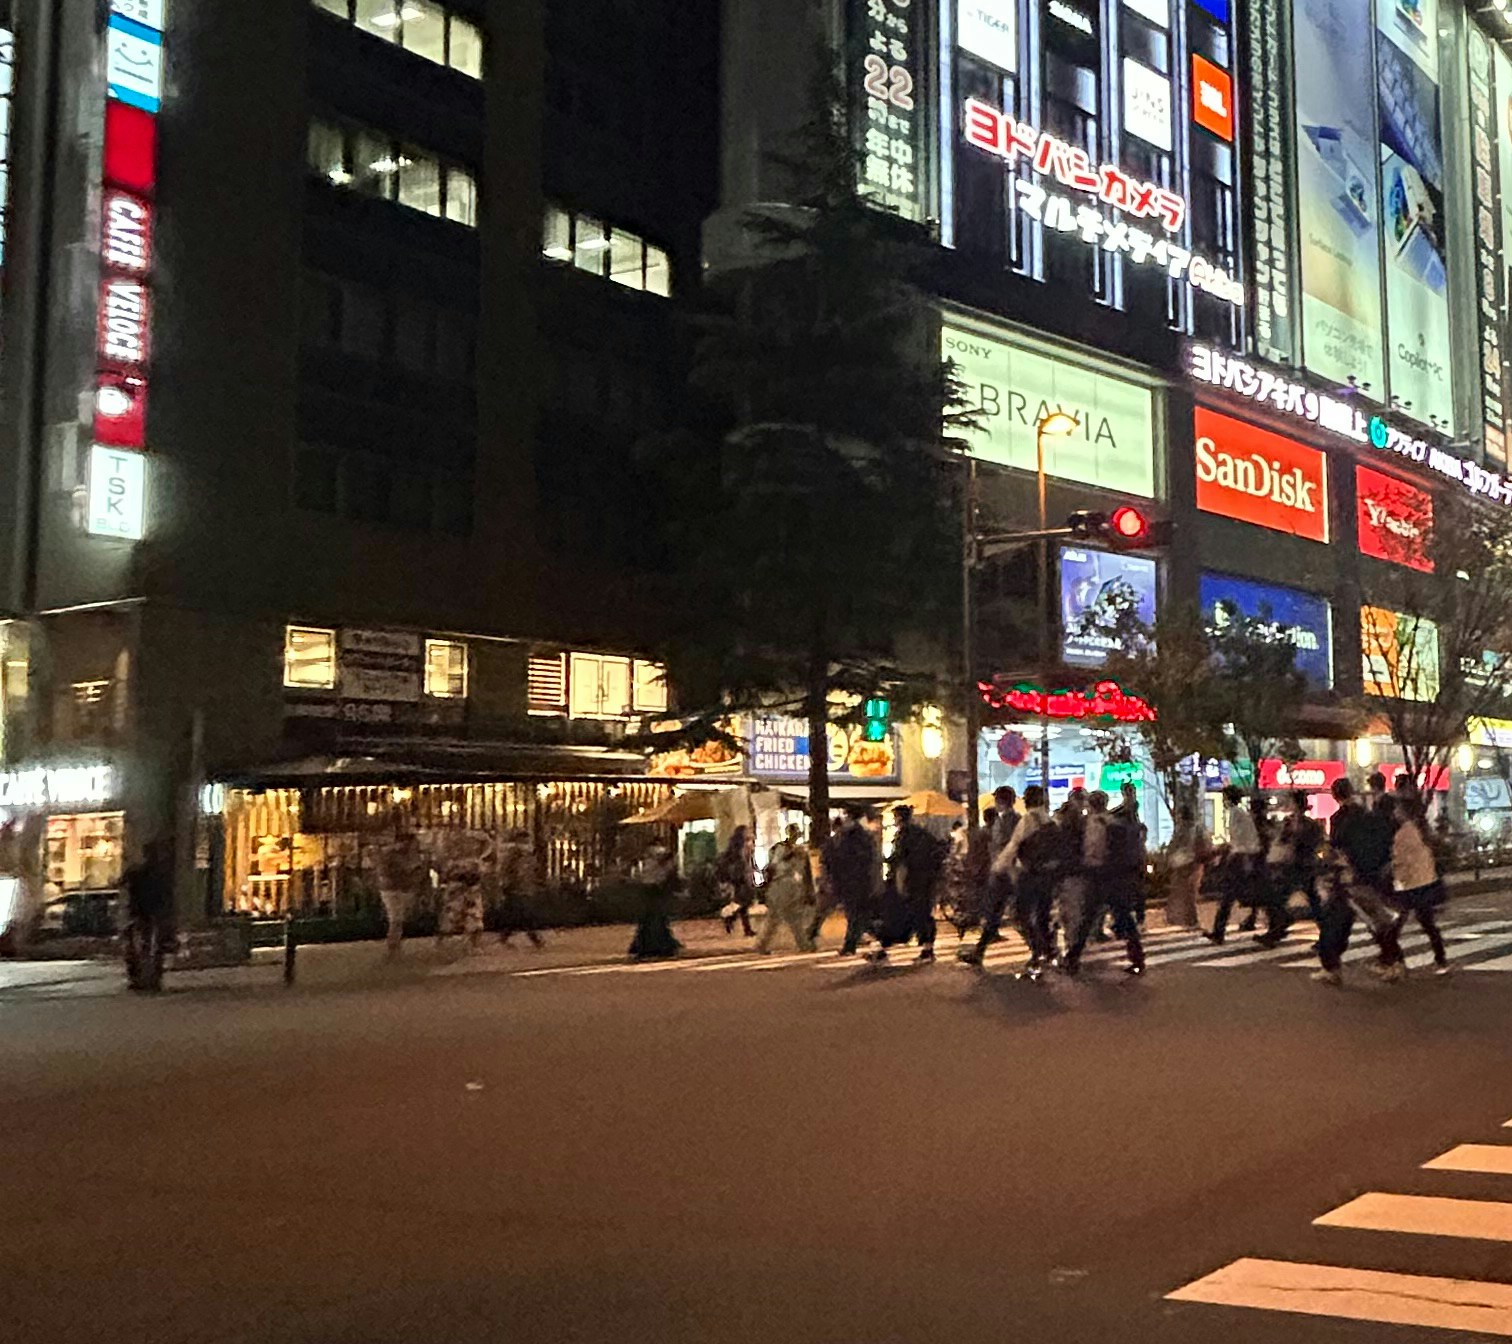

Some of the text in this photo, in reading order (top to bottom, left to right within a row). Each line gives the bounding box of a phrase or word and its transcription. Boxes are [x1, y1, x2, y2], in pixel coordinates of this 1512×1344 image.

[864, 53, 914, 111] 22
[965, 96, 1186, 233] ヨドバシカメラ
[105, 283, 143, 361] VELOCE
[945, 336, 992, 360] SONY
[1195, 437, 1316, 513] SanDisk
[754, 737, 796, 754] FRIED
